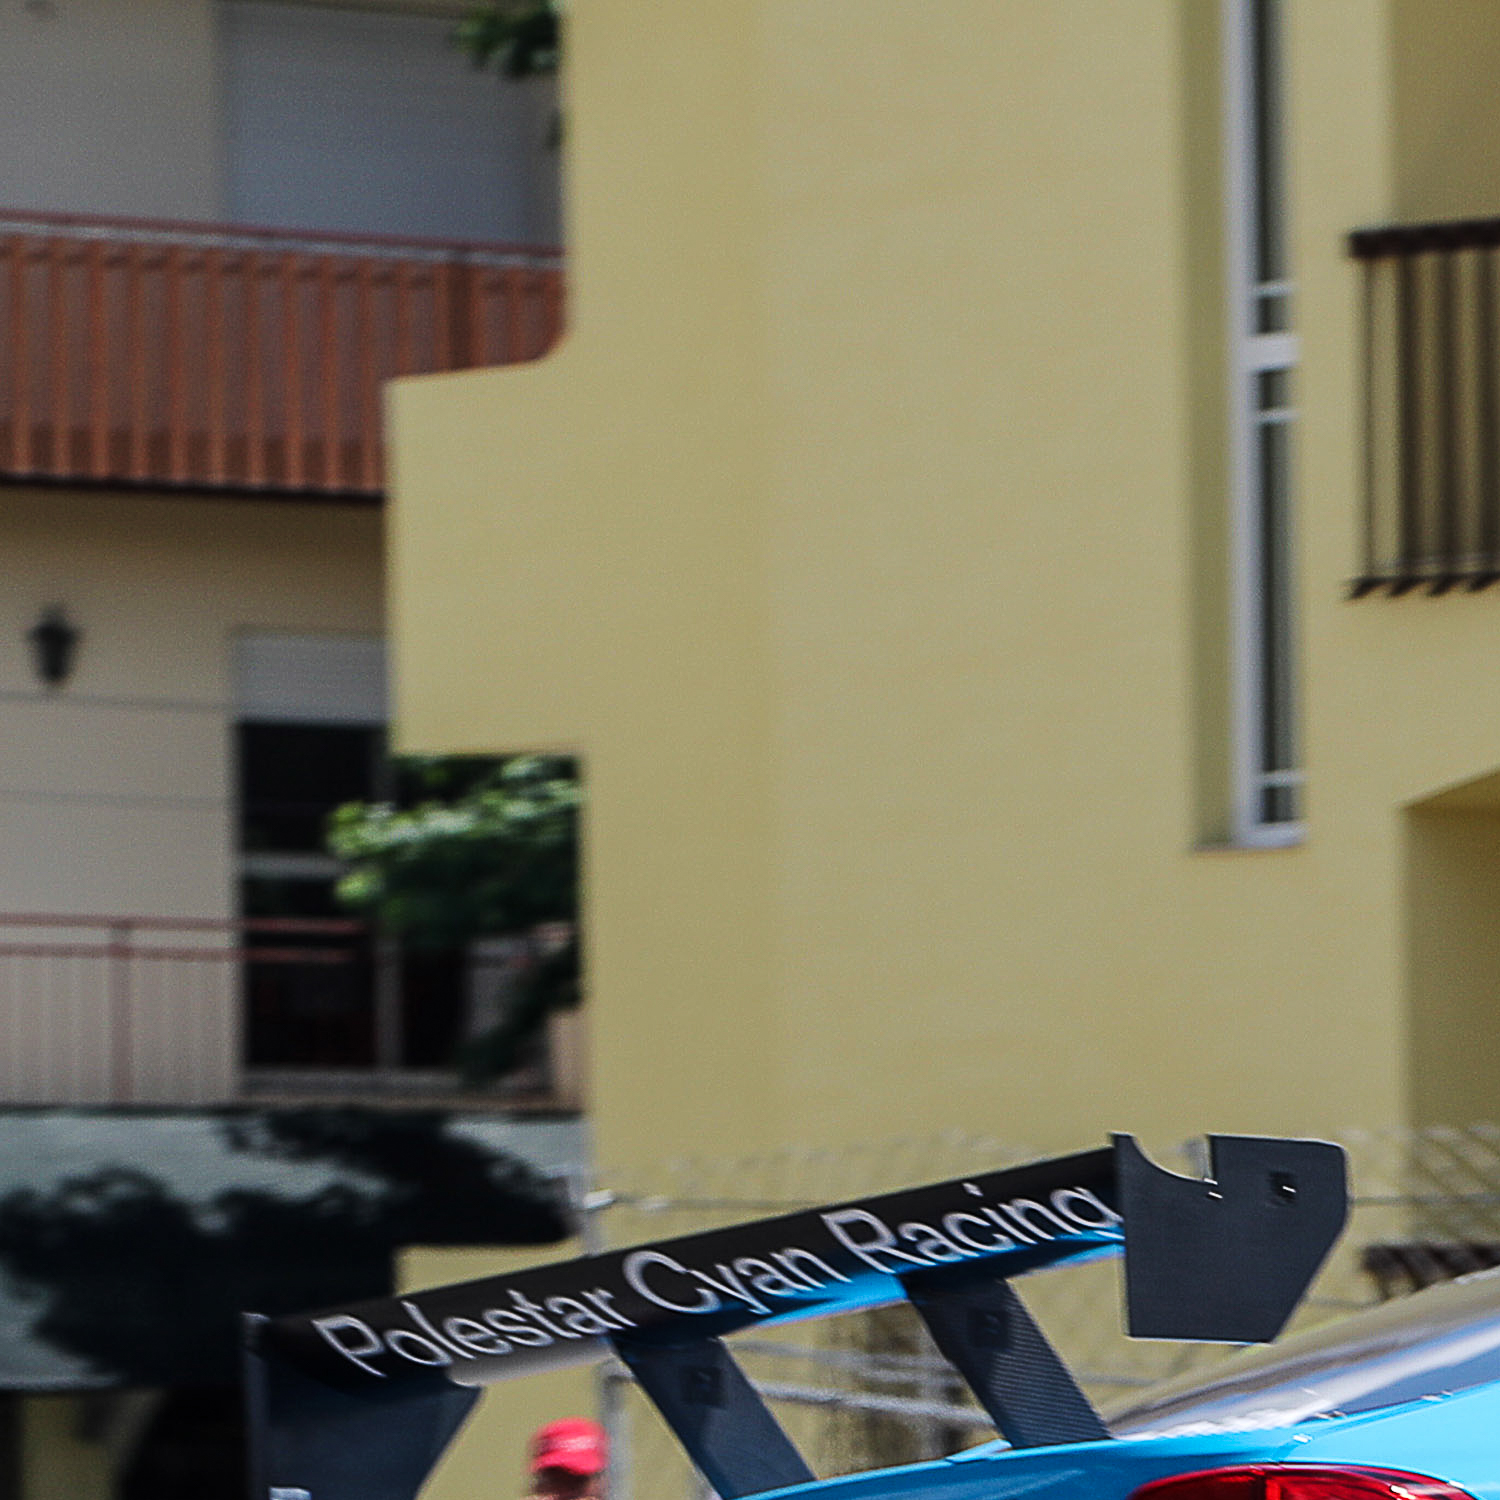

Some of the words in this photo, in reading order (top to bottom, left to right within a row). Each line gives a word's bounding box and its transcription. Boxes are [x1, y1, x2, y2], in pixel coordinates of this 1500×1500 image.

[312, 1289, 639, 1379] Polestar
[621, 1247, 853, 1316] Cyan
[819, 1181, 1126, 1275] Racing
